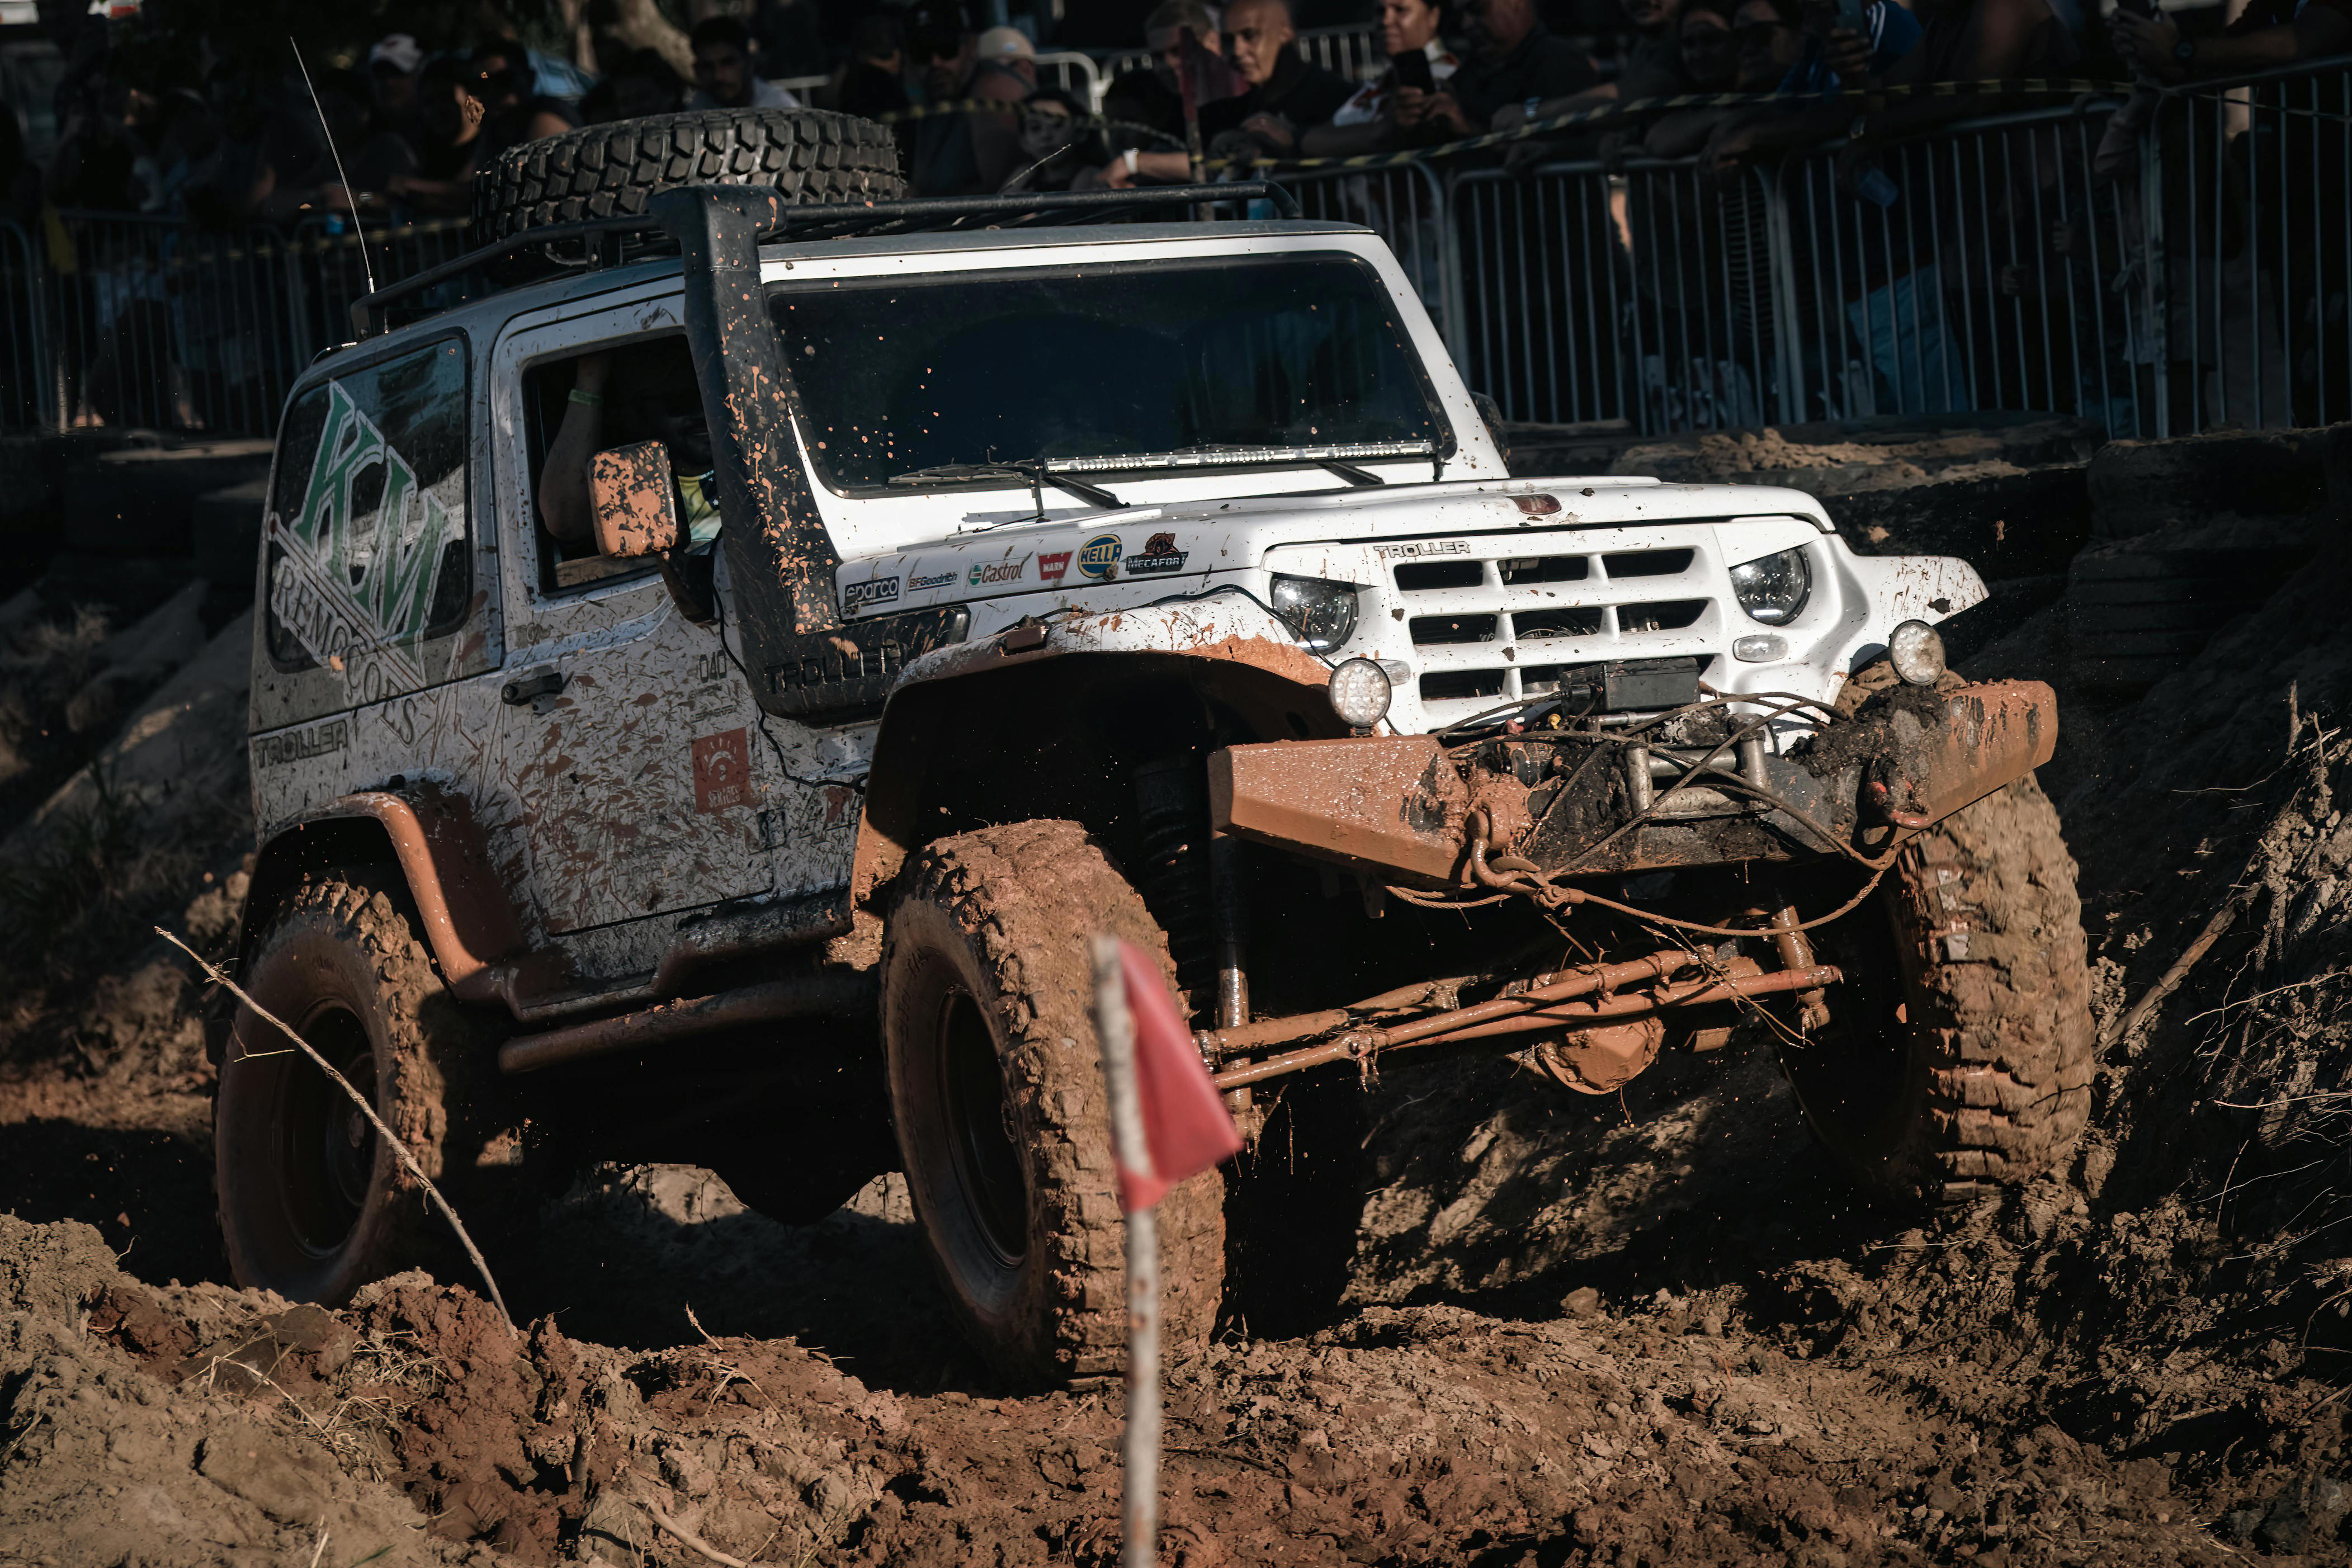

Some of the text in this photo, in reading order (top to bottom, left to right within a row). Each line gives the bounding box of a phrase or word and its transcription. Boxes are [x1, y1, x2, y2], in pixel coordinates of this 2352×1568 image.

[1081, 544, 1122, 563] HELLA
[1373, 541, 1470, 559] TROLLER
[1127, 552, 1188, 569] MECAFORT
[908, 572, 958, 588] BFGoodrich
[982, 561, 1024, 583] Castrol
[254, 719, 348, 768] TROLLER
